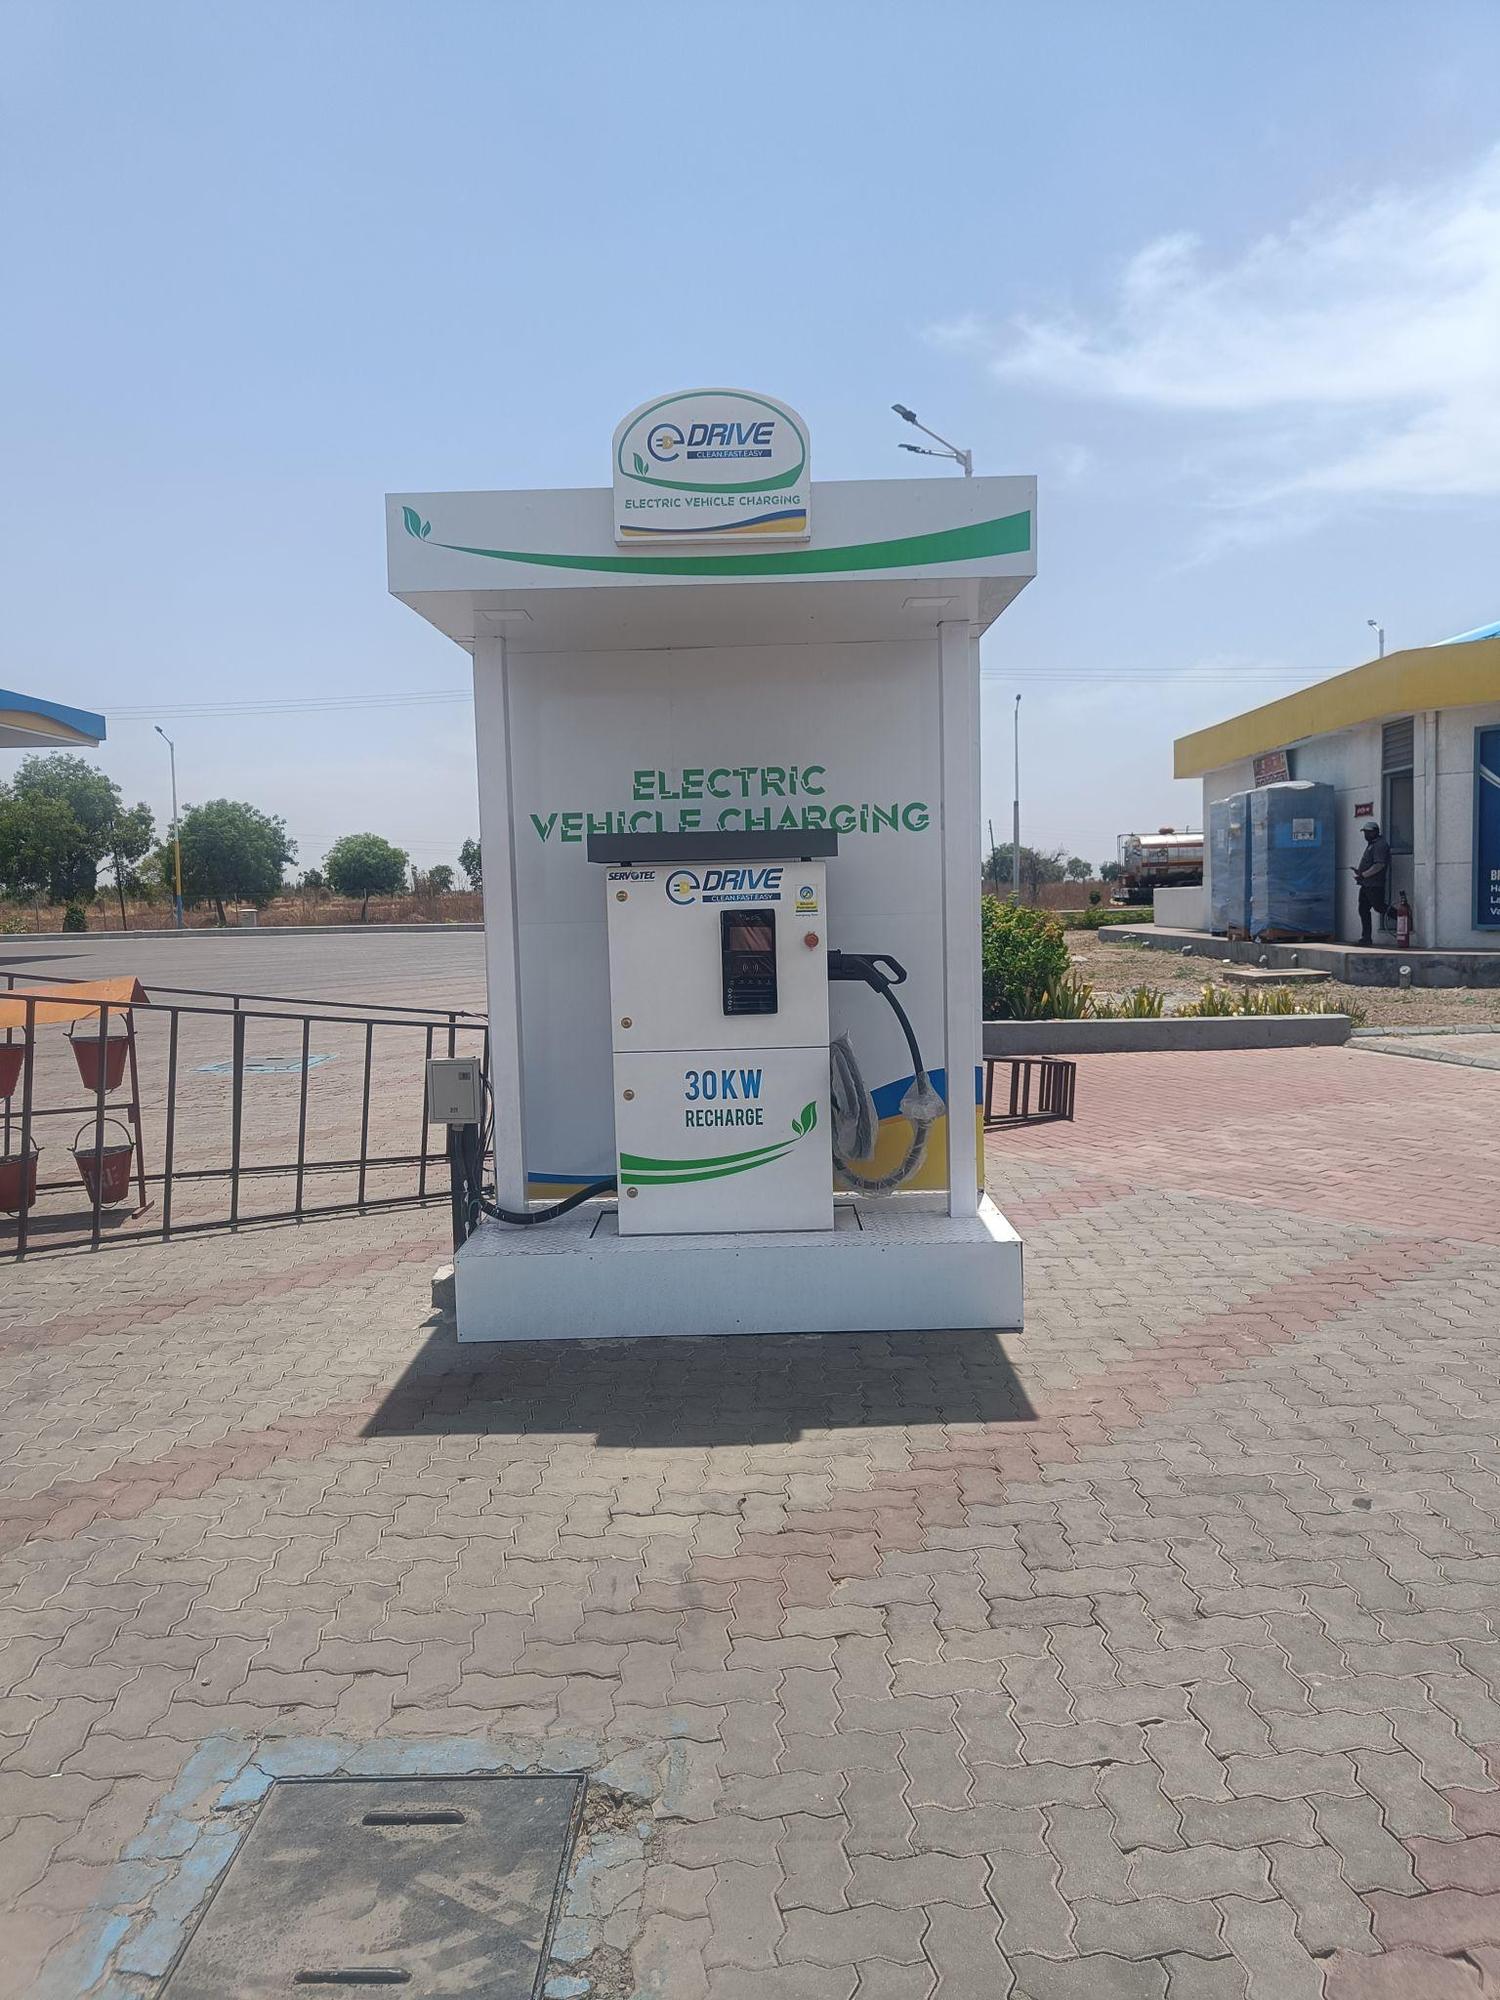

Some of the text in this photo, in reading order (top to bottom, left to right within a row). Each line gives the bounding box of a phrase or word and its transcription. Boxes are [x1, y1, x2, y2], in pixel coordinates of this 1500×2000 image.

[625, 494, 801, 509] ELECTRIC VEHICLE CHARGING
[633, 765, 826, 800] ELECTRIC
[529, 802, 930, 842] VEHICLE CHARGING
[608, 871, 656, 880] SERVOTEC
[685, 1069, 762, 1100] 30KW
[685, 1108, 764, 1127] RECHARGE
